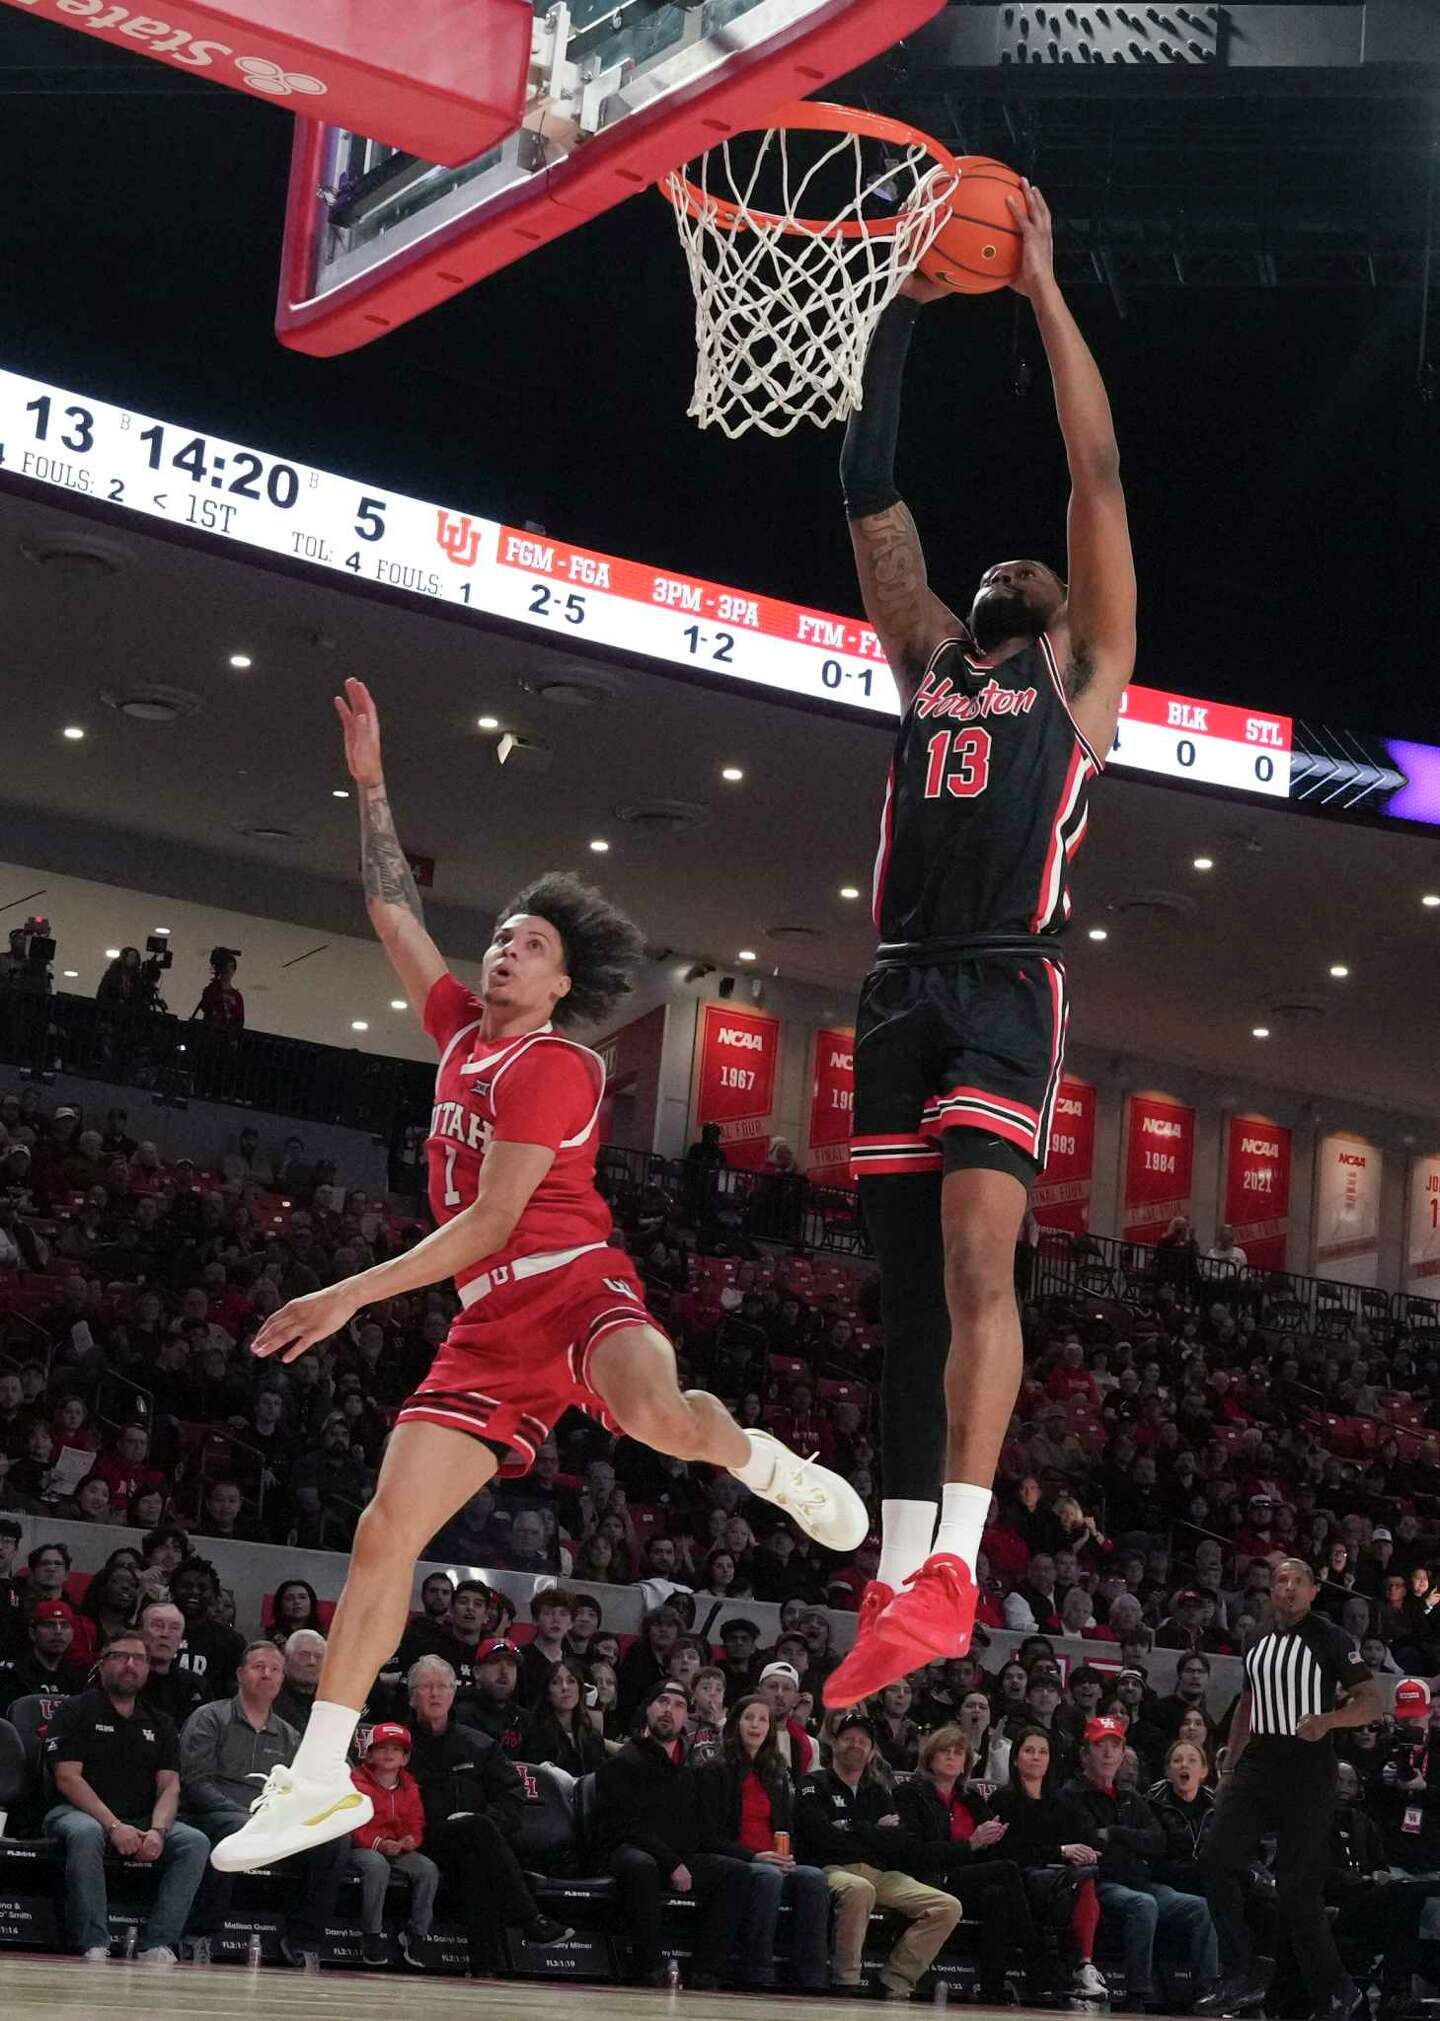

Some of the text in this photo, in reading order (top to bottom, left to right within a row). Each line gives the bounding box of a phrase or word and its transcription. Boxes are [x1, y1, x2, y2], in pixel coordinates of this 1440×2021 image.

[56, 0, 233, 66] State
[26, 395, 94, 453] 13
[22, 451, 95, 494] FOULS:
[107, 478, 126, 503] 2
[140, 425, 300, 509] 14:20
[186, 494, 237, 533] 1ST
[354, 496, 387, 542] 5
[292, 531, 472, 603] TOL: 4 FOULS: 1
[917, 670, 1038, 721] Houston
[1167, 701, 1209, 731] BLK
[1245, 719, 1283, 745] STL
[924, 726, 992, 799] 13
[1176, 740, 1196, 767] 0
[1254, 755, 1274, 782] 0
[717, 1027, 763, 1052] NCAA
[830, 1051, 854, 1071] NC
[720, 1066, 756, 1091] 1967
[831, 1088, 855, 1111] 19
[1056, 1098, 1082, 1117] CAA
[429, 1101, 496, 1155] UTAH
[1142, 1117, 1182, 1139] NCAA
[1050, 1133, 1076, 1155] 983
[1240, 1138, 1280, 1158] NCAA
[1144, 1151, 1176, 1174] 1984
[1338, 1153, 1366, 1168] NCAA
[444, 1144, 461, 1206] 1
[490, 1265, 509, 1286] U
